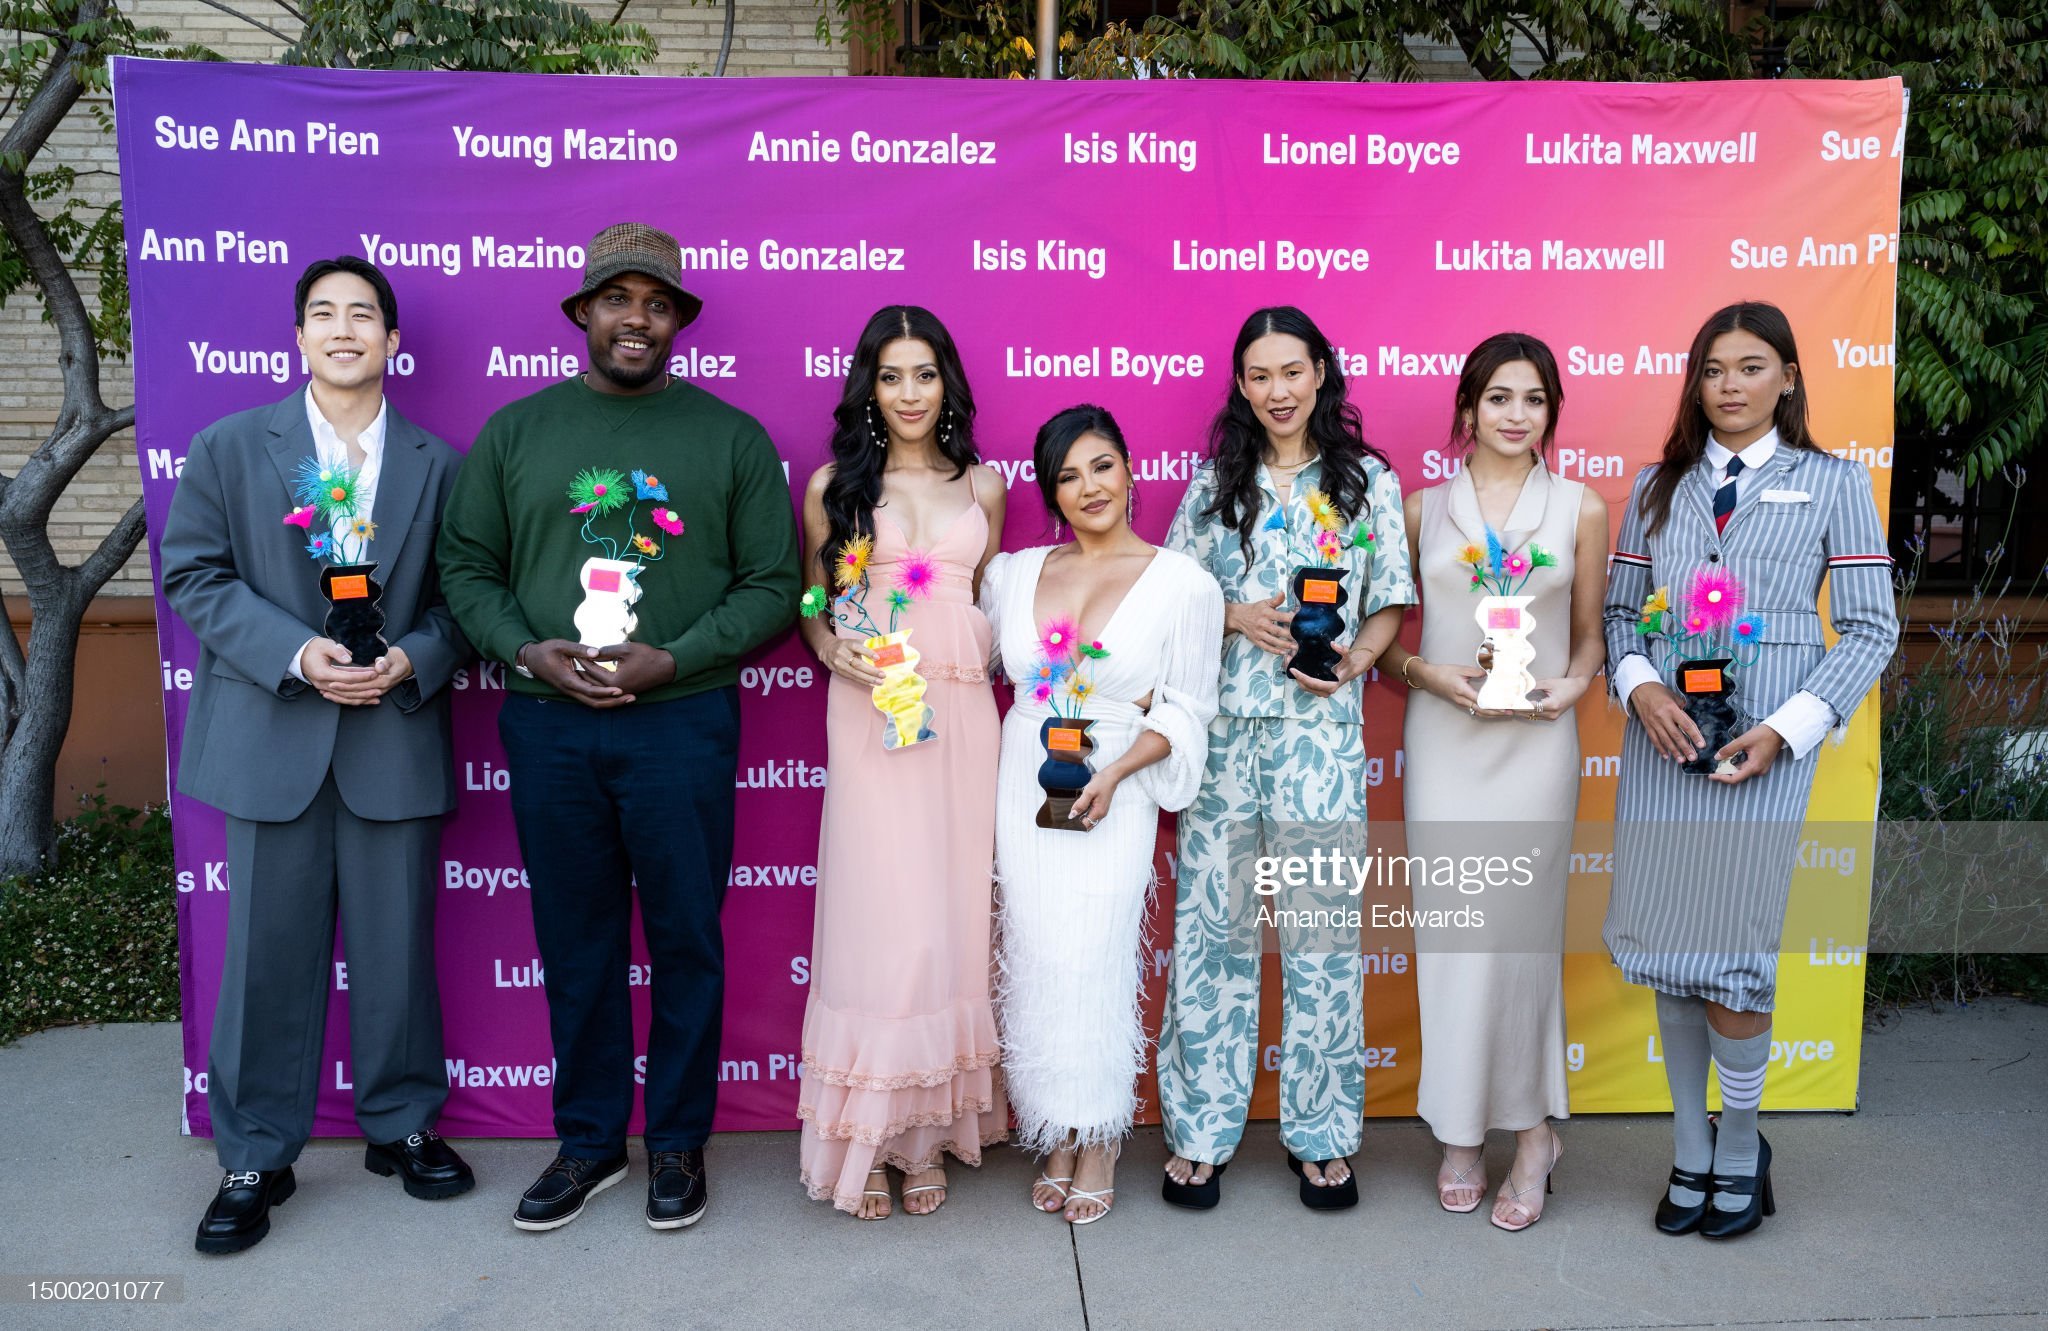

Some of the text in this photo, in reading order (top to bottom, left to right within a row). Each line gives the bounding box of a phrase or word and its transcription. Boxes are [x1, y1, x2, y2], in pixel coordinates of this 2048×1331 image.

[155, 116, 378, 155] Sue Ann Pien
[453, 126, 677, 167] Young Mazino
[748, 131, 996, 164] Annie Gonzalez
[1527, 132, 1756, 164] Lukita Maxwell
[1821, 131, 1880, 161] Sue
[1065, 133, 1196, 172] Isis King
[1264, 133, 1460, 173] Lionel Boyce
[140, 229, 205, 261] Ann
[216, 231, 288, 263] Pien
[360, 234, 585, 275] Young Mazino
[681, 239, 904, 270] nnie Gonzalez
[974, 240, 1105, 279] Isis King
[1174, 240, 1369, 279] Lionel Boyce
[1436, 240, 1664, 270] Lukita Maxwell
[1731, 233, 1896, 268] Sue Ann Pi
[189, 342, 289, 383] Young
[487, 347, 578, 377] Annie
[670, 347, 737, 378] alez
[805, 347, 852, 377] Isis
[1007, 347, 1204, 384] Lionel Boyce
[1378, 346, 1466, 377] Maxw
[1568, 345, 1690, 375] Sue Ann
[1832, 338, 1894, 368] You
[1131, 452, 1200, 481] Lukit
[1423, 449, 1623, 480] Su Pien
[741, 666, 812, 696] oyce
[466, 762, 511, 791] Lio
[1581, 756, 1620, 777] nn
[445, 861, 532, 896] Boyce
[727, 863, 818, 887] axwe
[1363, 947, 1408, 974] nie
[1809, 937, 1866, 966] Lio
[494, 959, 545, 988] Luk
[1768, 1039, 1834, 1069] oyce
[445, 1058, 557, 1088] Maxwel
[717, 1061, 759, 1083] nn
